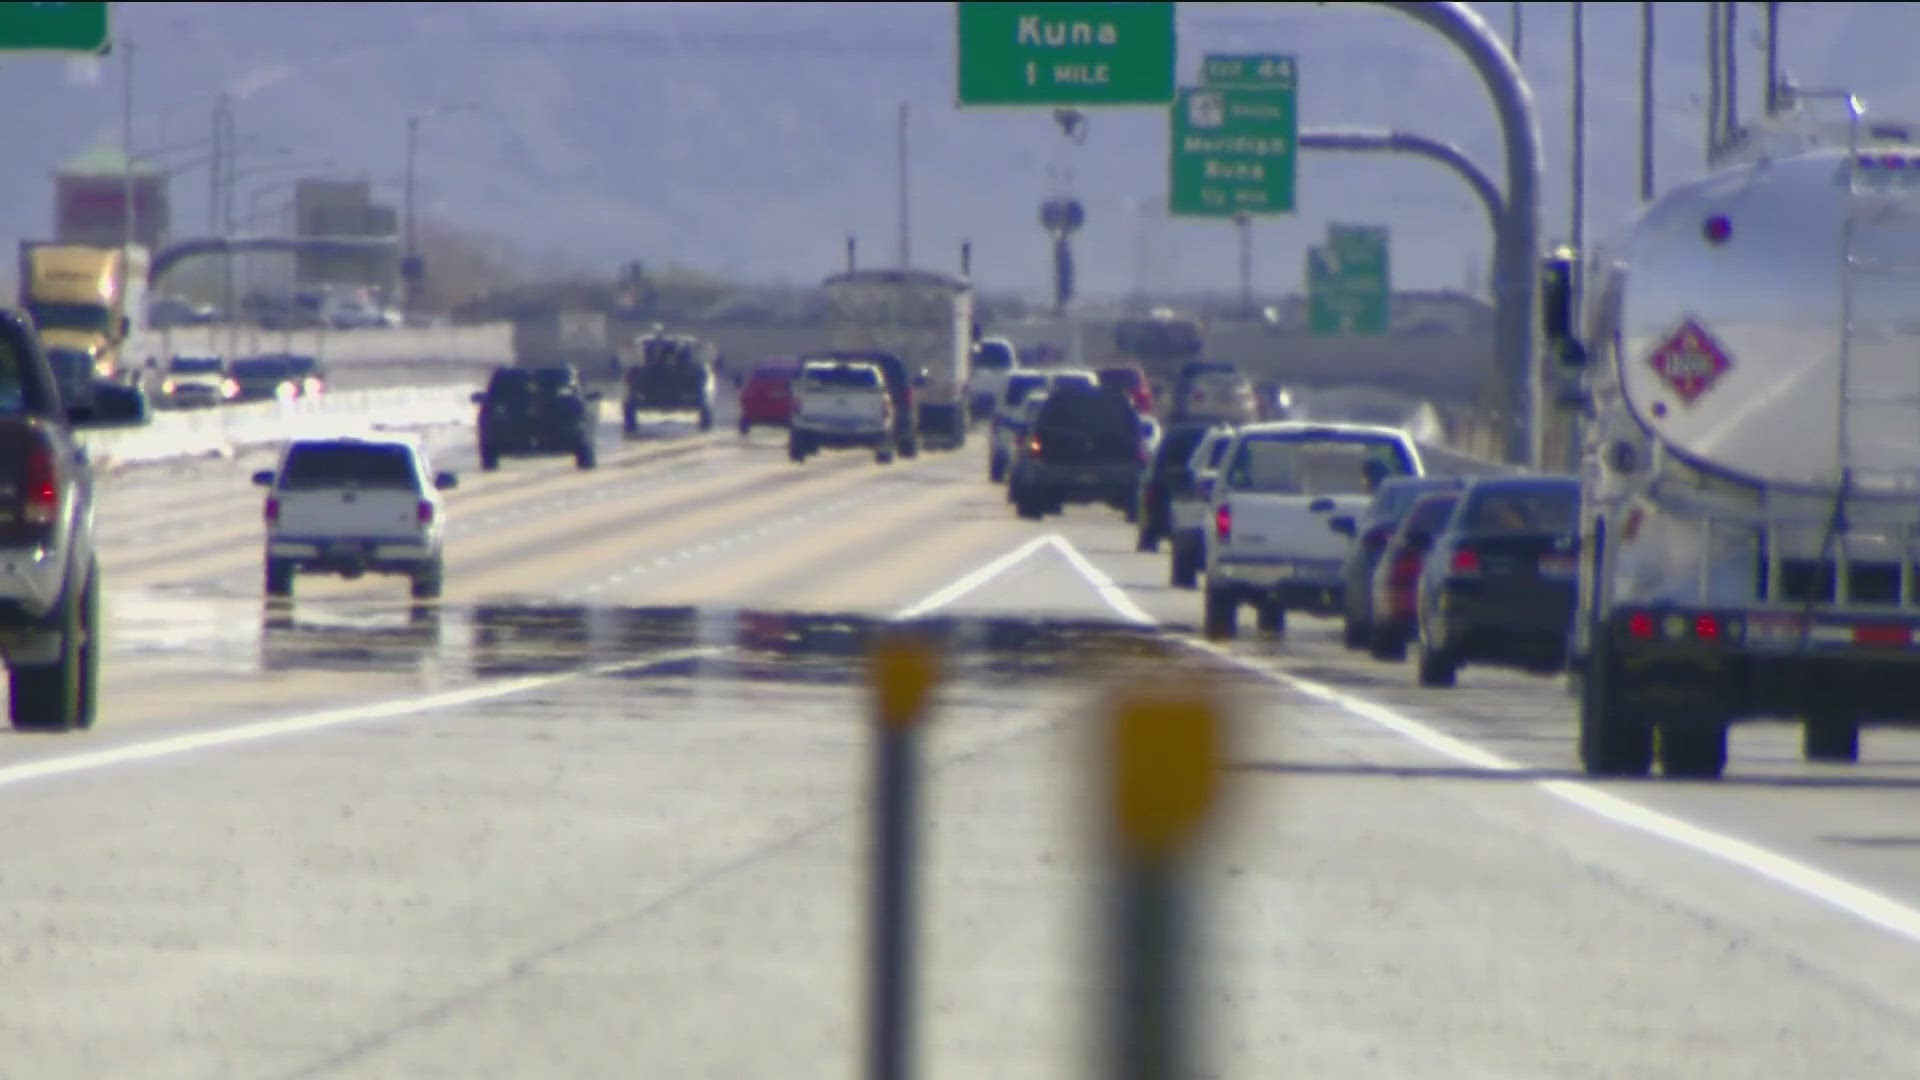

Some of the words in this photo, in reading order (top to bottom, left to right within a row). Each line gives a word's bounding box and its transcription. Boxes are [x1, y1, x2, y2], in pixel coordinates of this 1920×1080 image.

[1018, 15, 1118, 46] Kuna
[1026, 62, 1037, 86] 1
[1054, 64, 1110, 84] MILE
